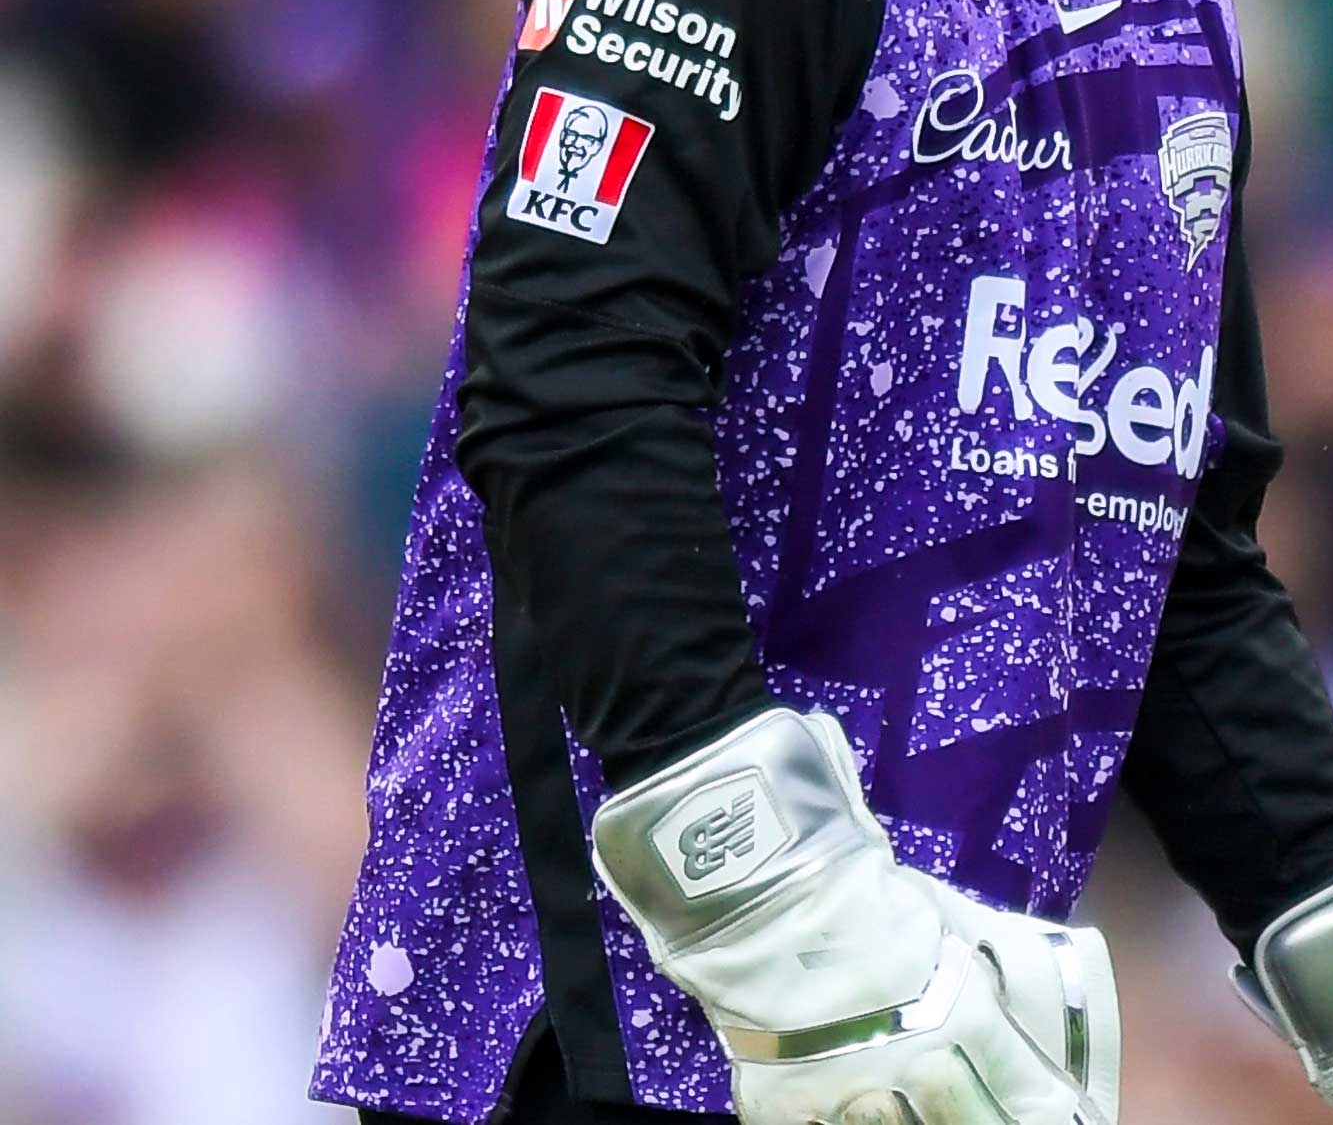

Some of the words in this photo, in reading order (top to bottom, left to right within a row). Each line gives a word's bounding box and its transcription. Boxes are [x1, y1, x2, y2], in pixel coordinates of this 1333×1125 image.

[565, 14, 744, 122] Security
[521, 190, 600, 232] KFC
[951, 436, 1059, 479] Loans
